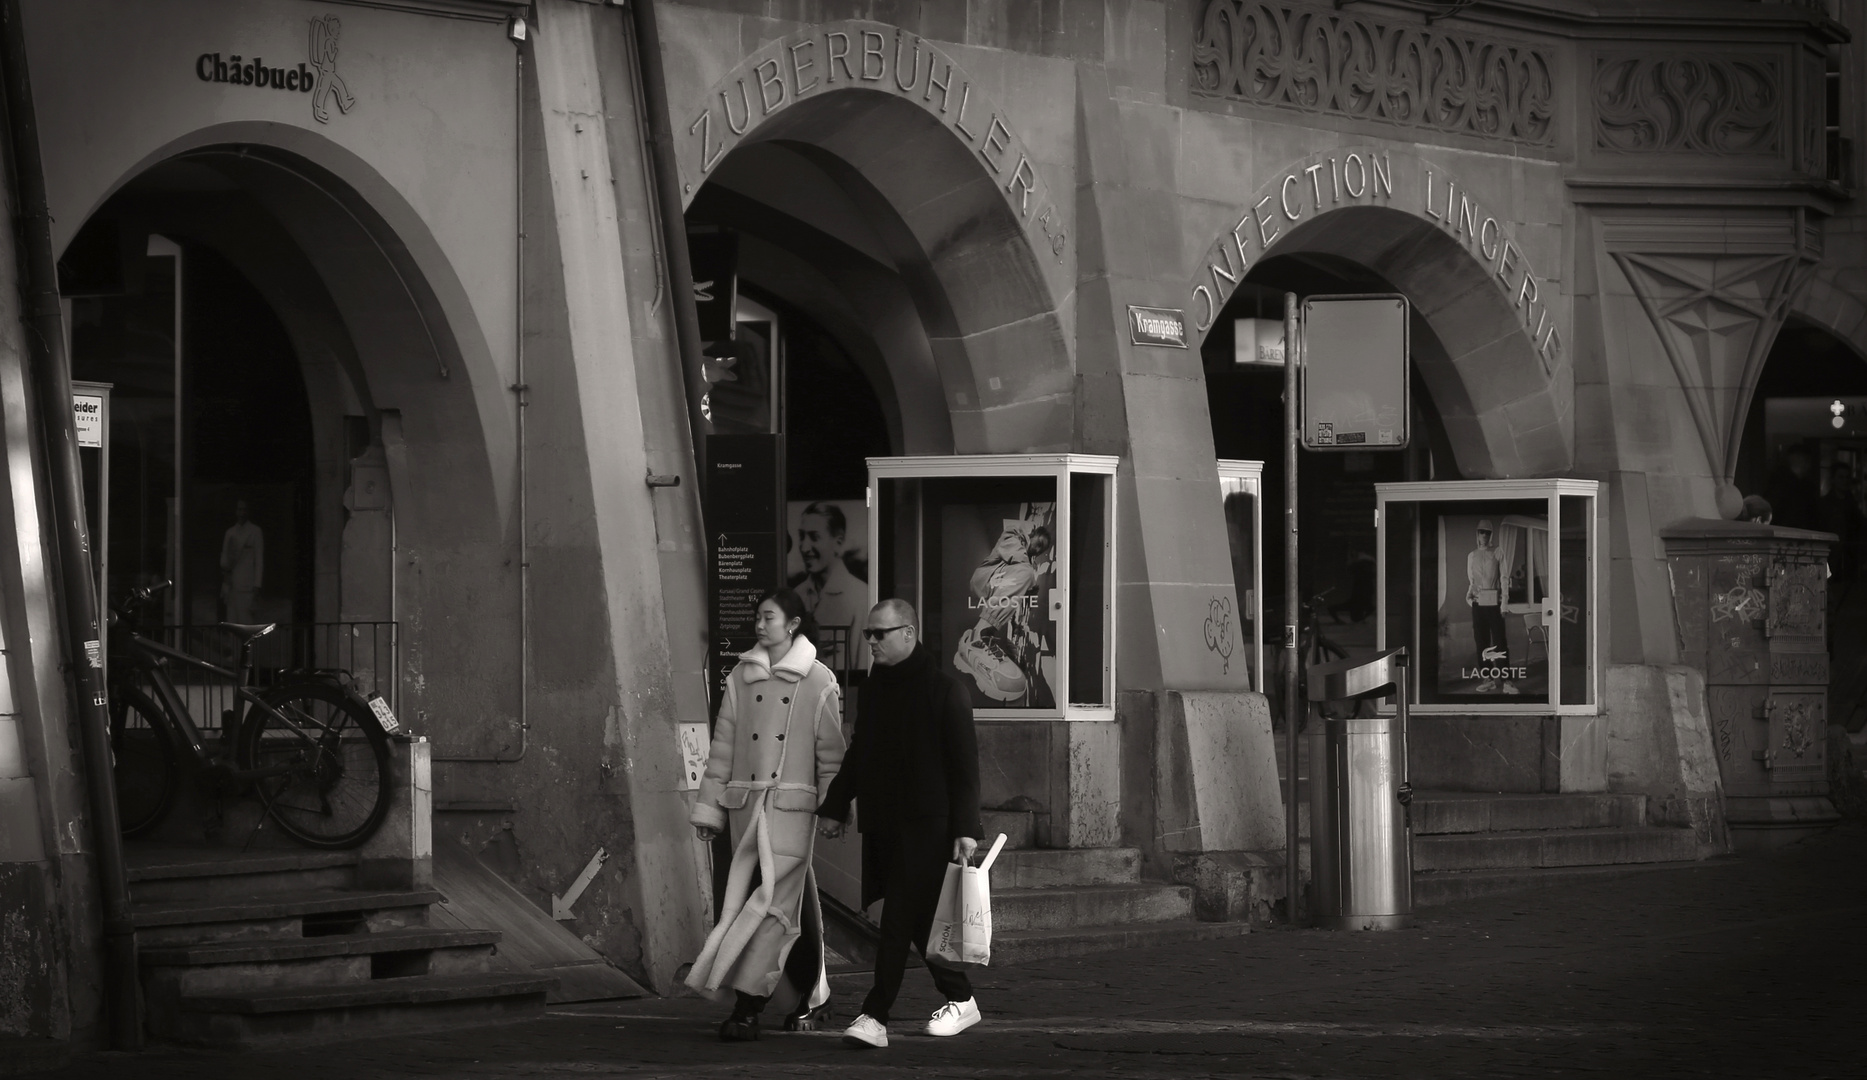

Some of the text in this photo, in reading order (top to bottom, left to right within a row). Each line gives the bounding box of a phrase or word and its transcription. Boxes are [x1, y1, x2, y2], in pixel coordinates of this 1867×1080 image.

[196, 53, 314, 93] Chäsbueb
[689, 28, 1035, 217] ZUBERBÜHLER
[1425, 170, 1562, 377] LINGERIE
[1135, 312, 1184, 340] Kramgasse
[968, 595, 1038, 609] LACOSTE
[1461, 667, 1527, 679] LACOSTE
